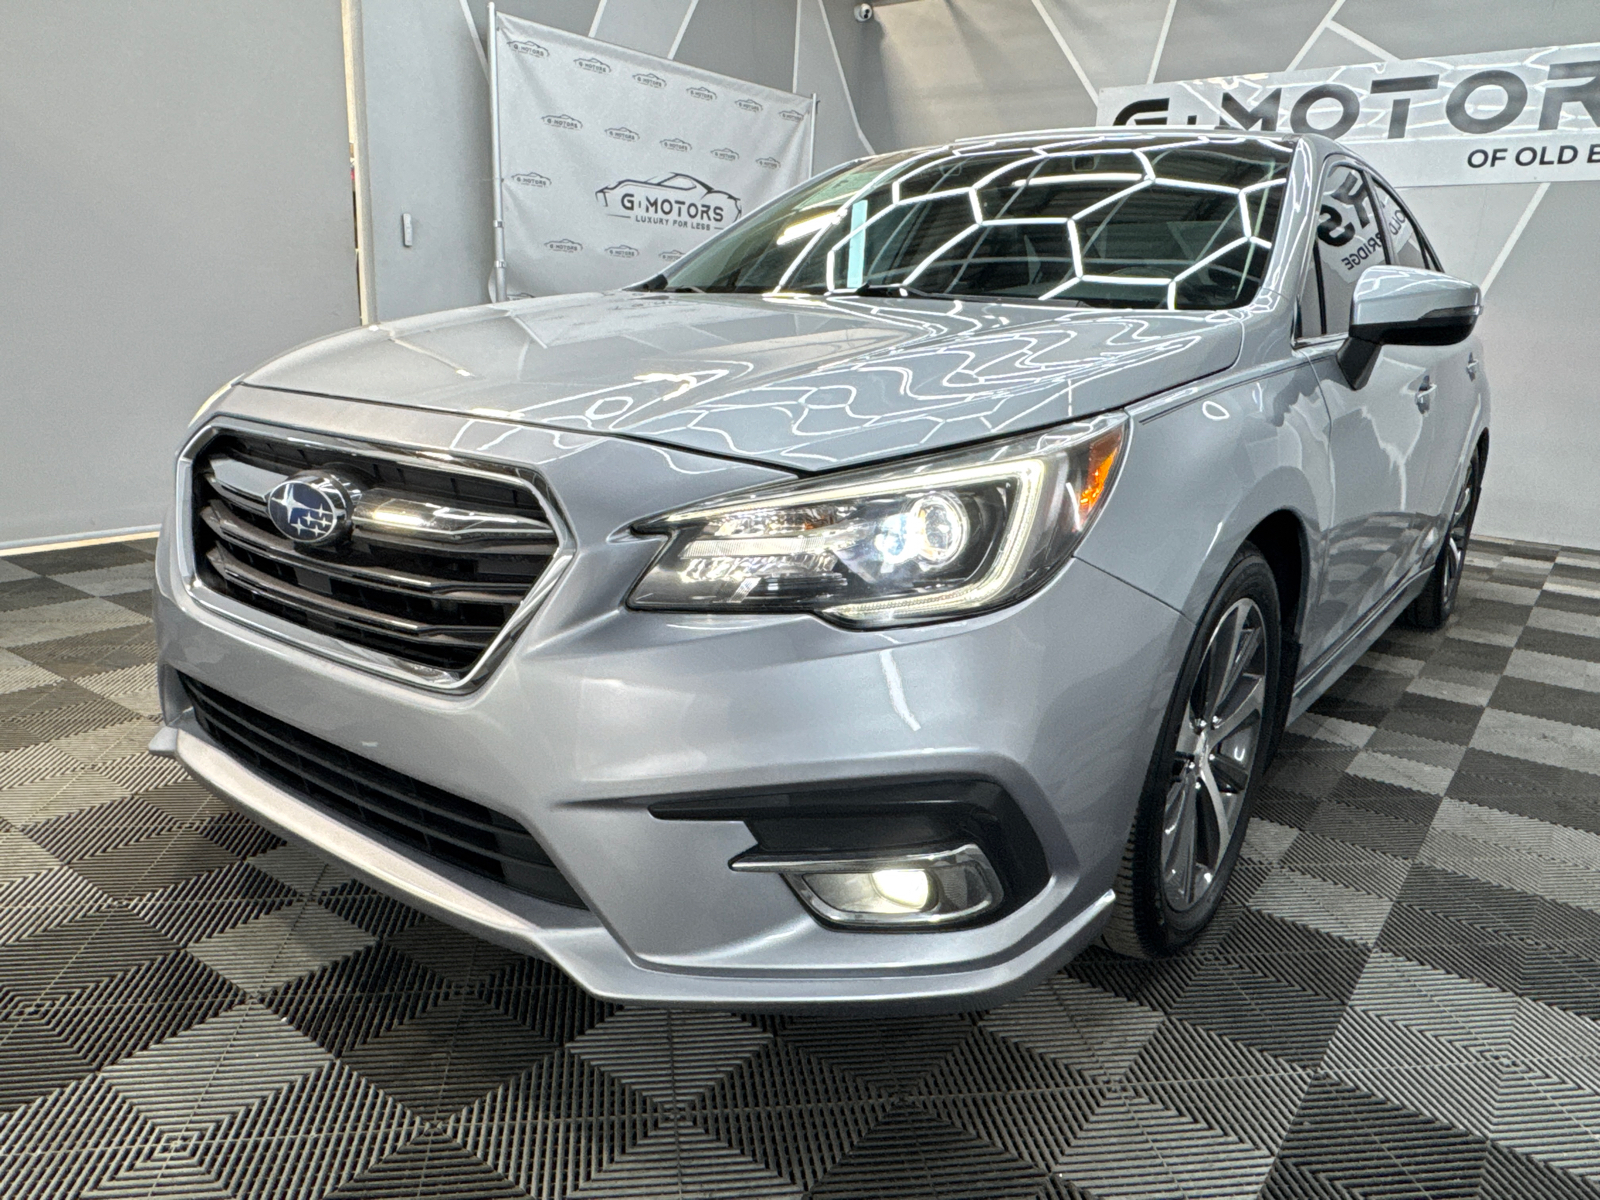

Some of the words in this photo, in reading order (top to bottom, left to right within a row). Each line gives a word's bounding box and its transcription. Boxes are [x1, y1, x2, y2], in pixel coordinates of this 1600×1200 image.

[1467, 148, 1508, 169] OF
[1515, 145, 1578, 167] OLD
[645, 195, 724, 222] MOTORS
[635, 215, 669, 226] LUXURY
[672, 220, 688, 228] FOR
[691, 223, 711, 231] LESS
